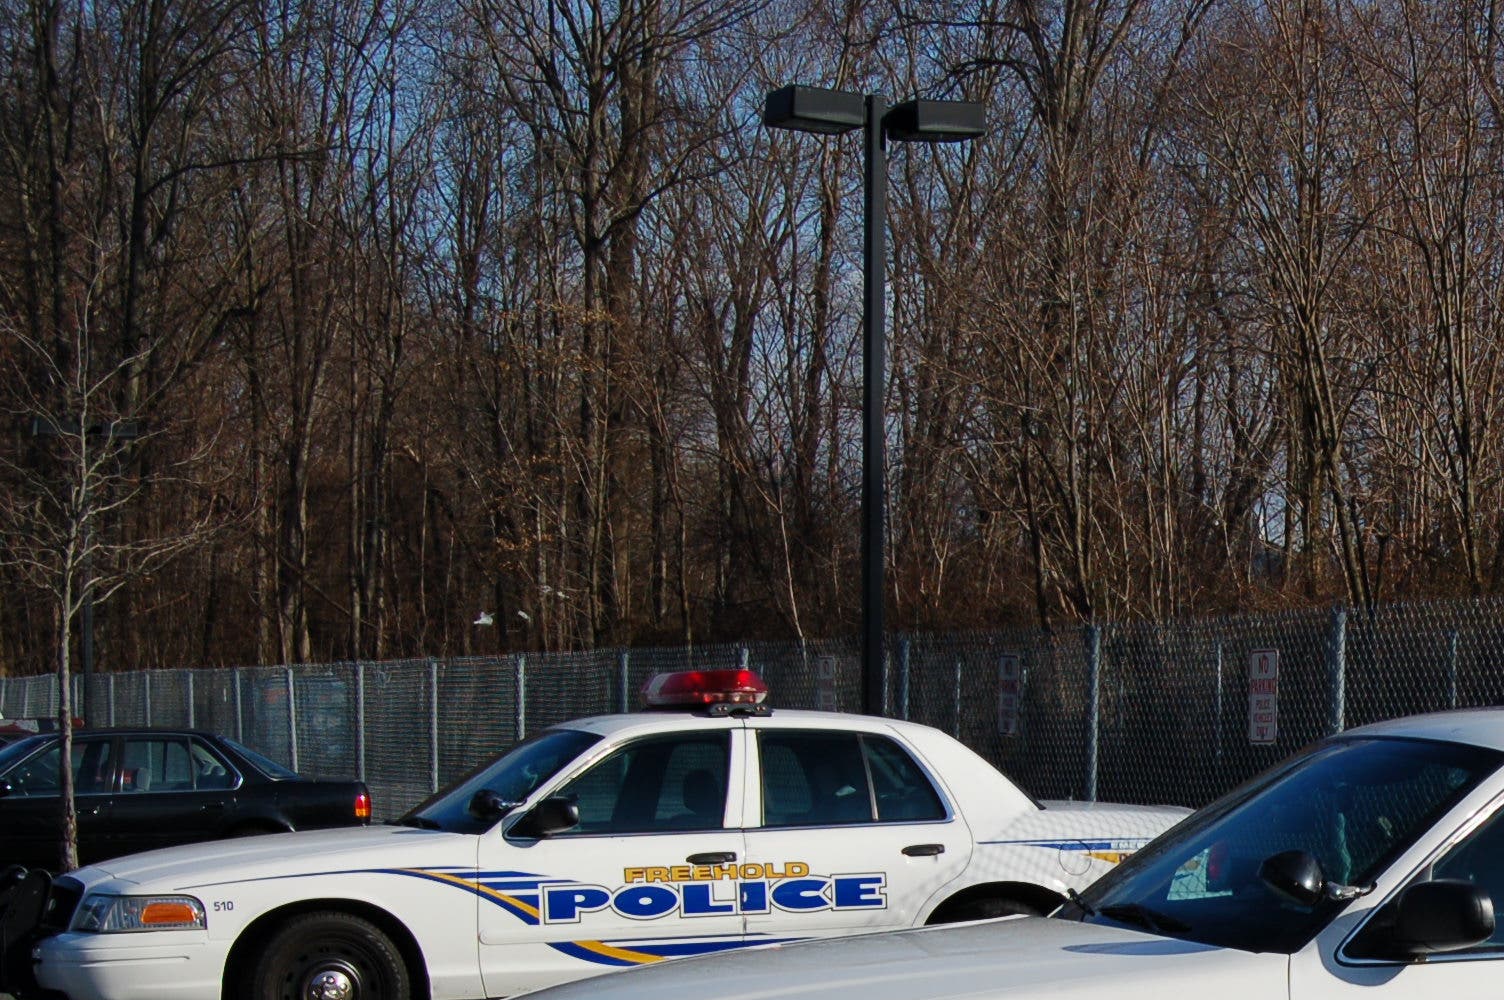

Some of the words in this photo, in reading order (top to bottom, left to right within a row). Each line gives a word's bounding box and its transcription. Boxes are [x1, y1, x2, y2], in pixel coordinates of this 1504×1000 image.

[623, 861, 810, 884] FREEHOLD
[213, 901, 234, 911] 510
[543, 872, 887, 925] POLICE
